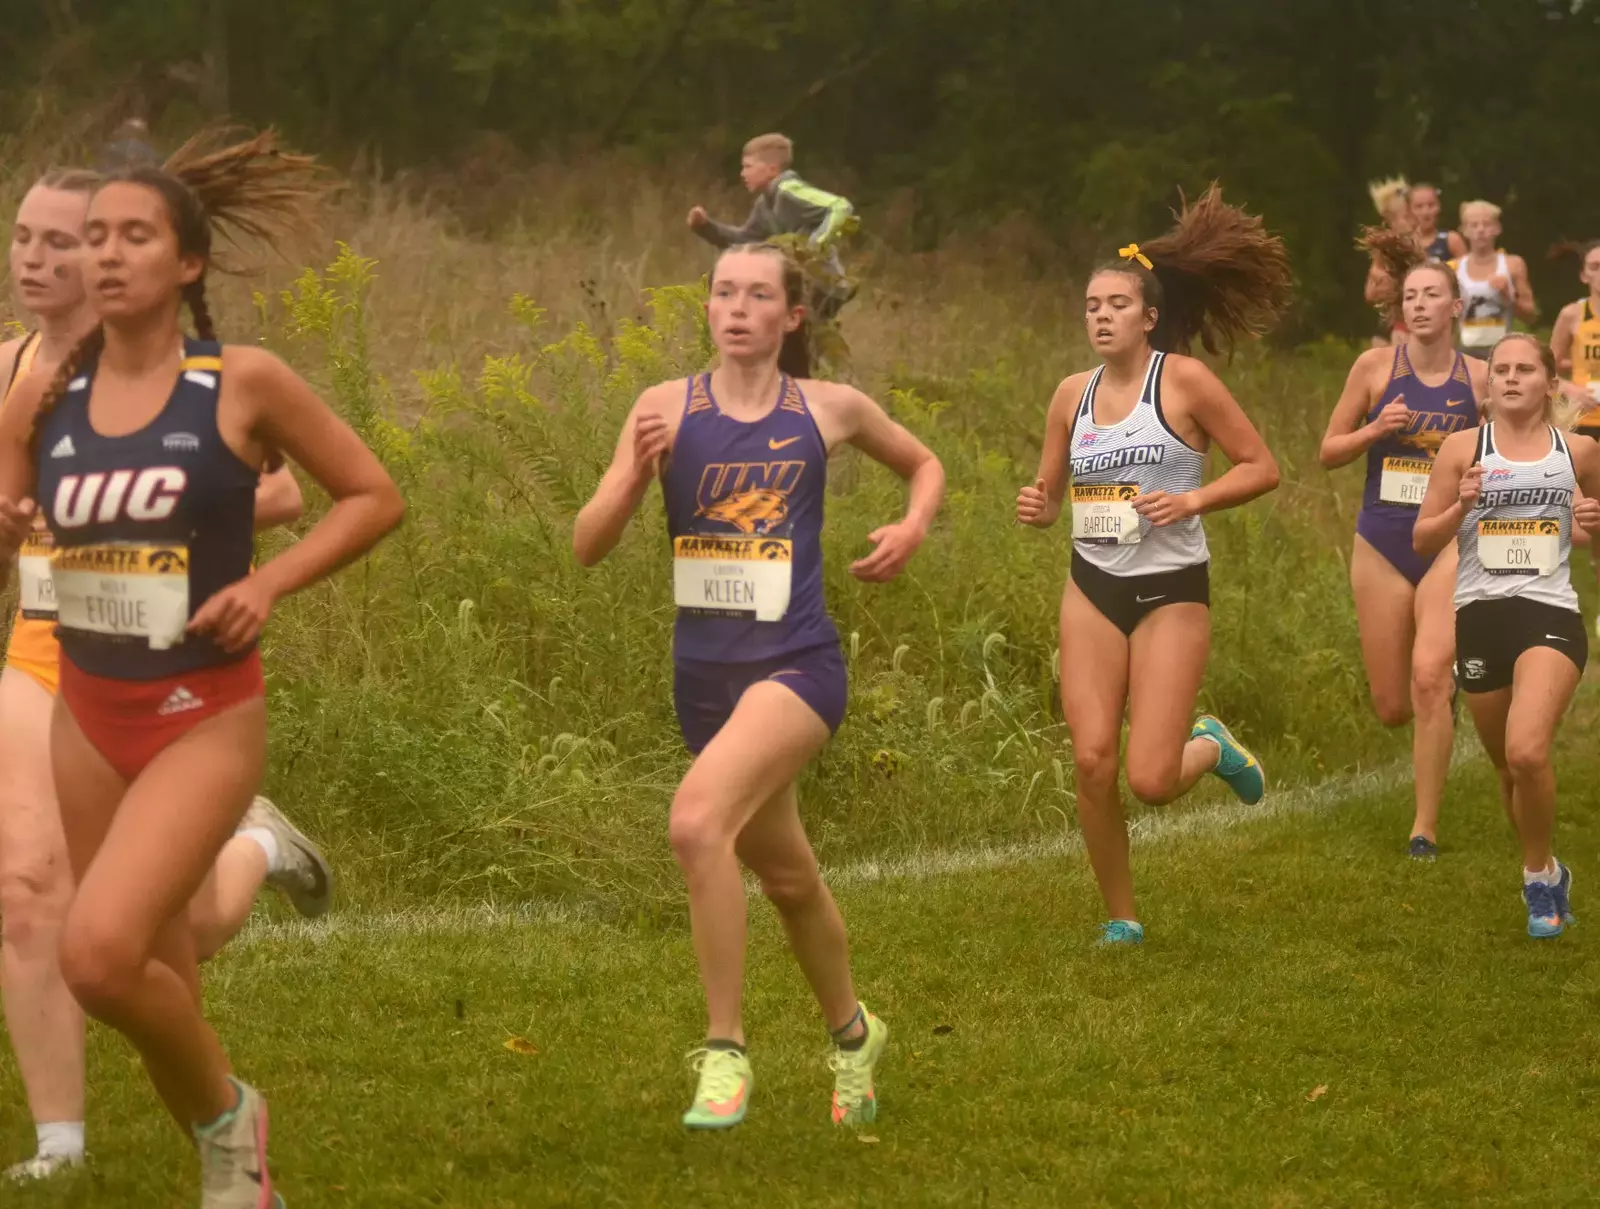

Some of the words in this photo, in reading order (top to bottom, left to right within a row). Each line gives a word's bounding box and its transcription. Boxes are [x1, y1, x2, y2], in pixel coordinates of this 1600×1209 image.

[697, 460, 806, 510] UNI
[1074, 486, 1116, 497] HAWKEYE
[1400, 484, 1427, 501] RILE
[53, 466, 187, 529] UIC
[1083, 516, 1122, 534] BARICH
[1483, 521, 1536, 531] HAWKEYE
[679, 538, 755, 553] HAWKEYE
[1511, 538, 1527, 546] KATE
[1507, 548, 1532, 565] COX
[703, 578, 755, 604] KLIEN
[85, 595, 149, 632] ETQUE
